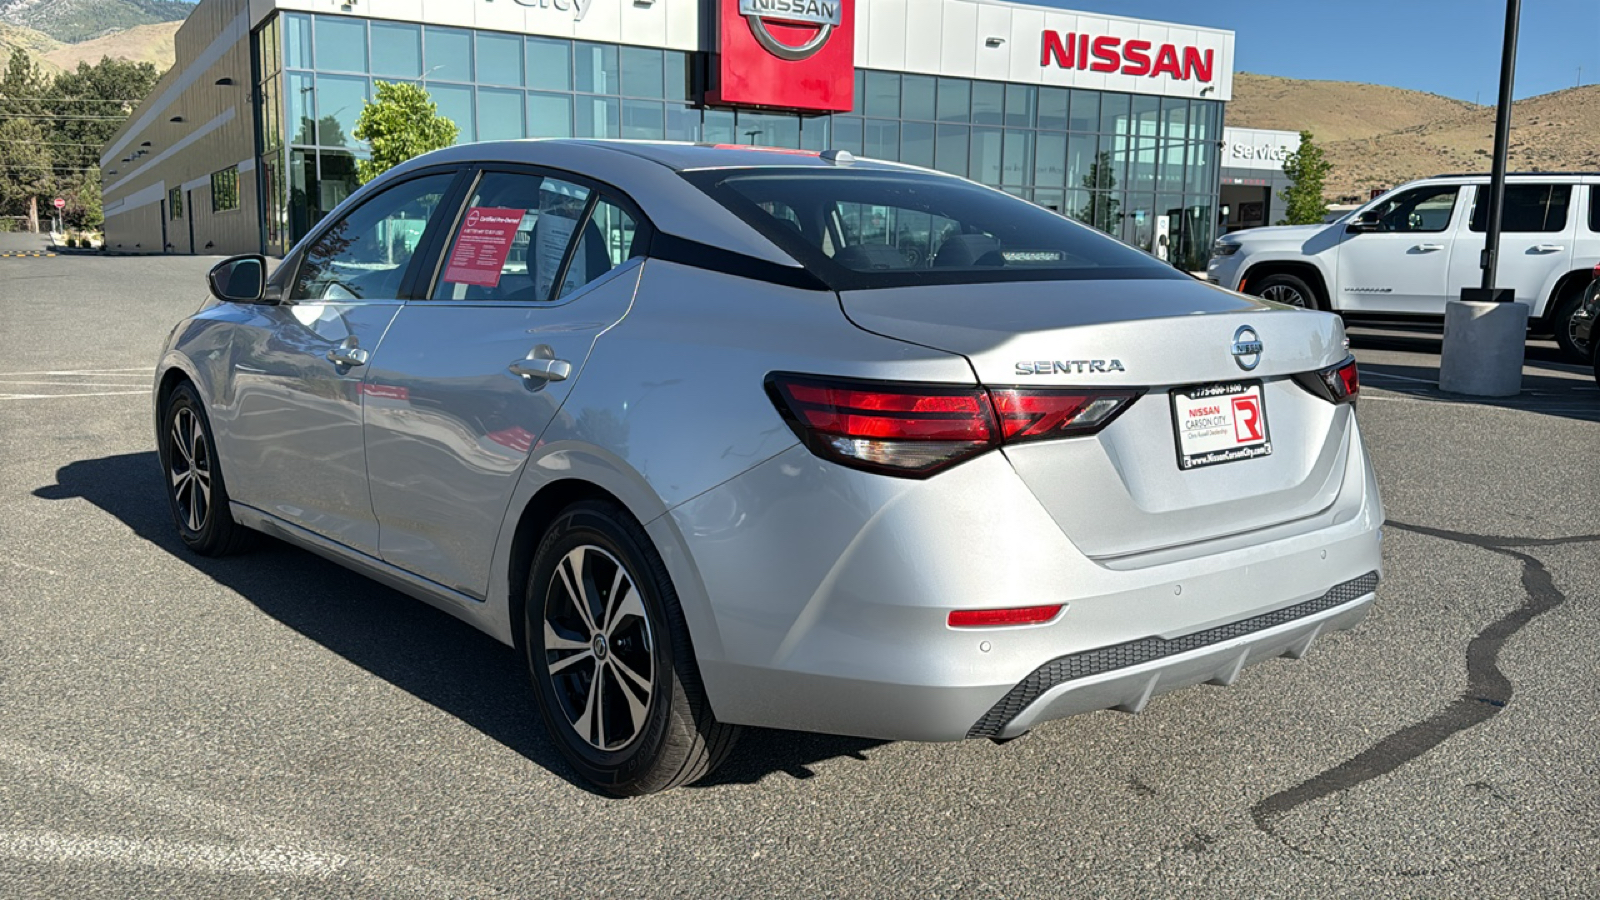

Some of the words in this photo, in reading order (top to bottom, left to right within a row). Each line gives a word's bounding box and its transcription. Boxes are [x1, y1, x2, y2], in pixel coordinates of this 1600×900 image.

[752, 0, 834, 19] NISSAN
[1040, 29, 1214, 83] NISSAN
[1233, 142, 1288, 161] Service
[1015, 359, 1125, 375] SENTRA
[1189, 406, 1220, 417] NISSAN
[1185, 417, 1212, 429] CARSON
[1213, 415, 1226, 426] CITY
